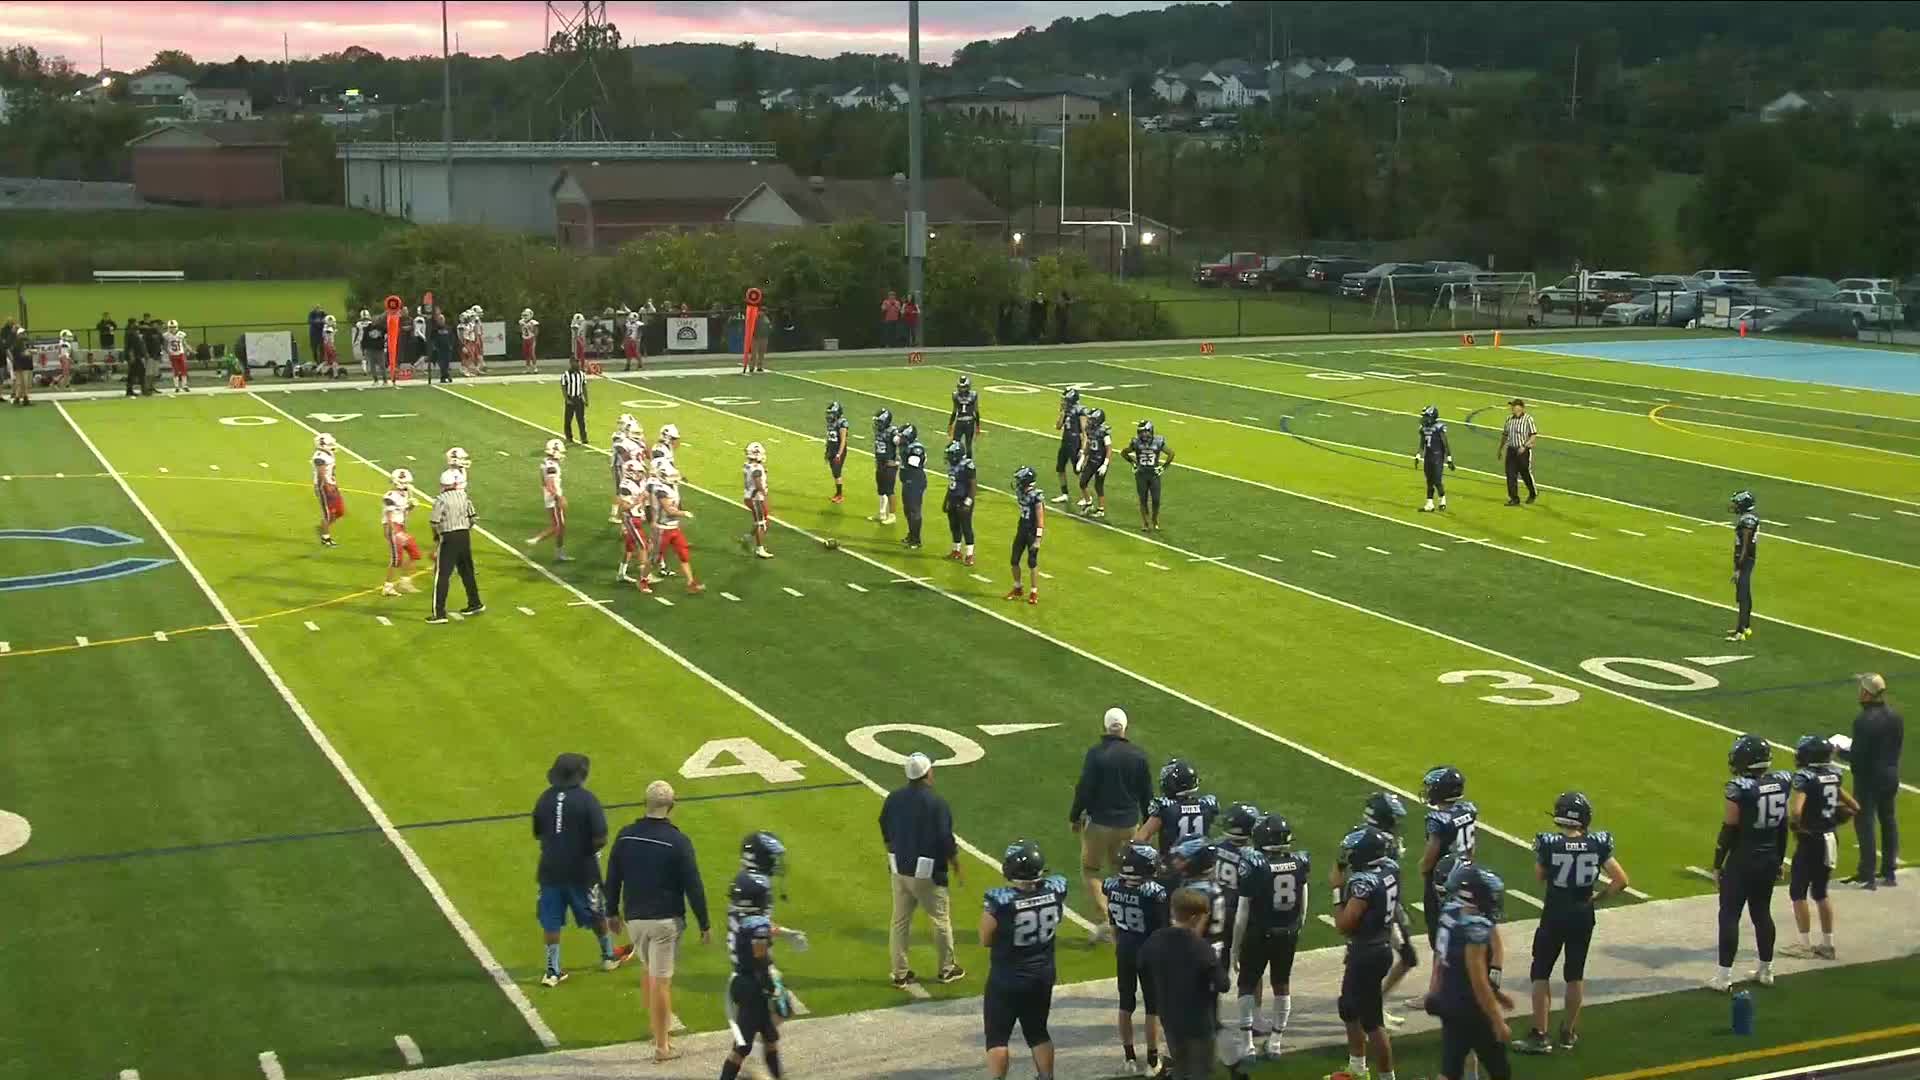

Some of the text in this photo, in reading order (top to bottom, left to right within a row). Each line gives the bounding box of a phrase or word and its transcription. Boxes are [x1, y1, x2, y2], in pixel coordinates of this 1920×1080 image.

[1139, 453, 1156, 466] 23
[1753, 793, 1786, 829] 15
[1822, 784, 1838, 818] 3
[1178, 815, 1204, 841] 11
[1551, 853, 1600, 888] 76
[1273, 874, 1297, 912] 8
[1013, 905, 1060, 946] 28
